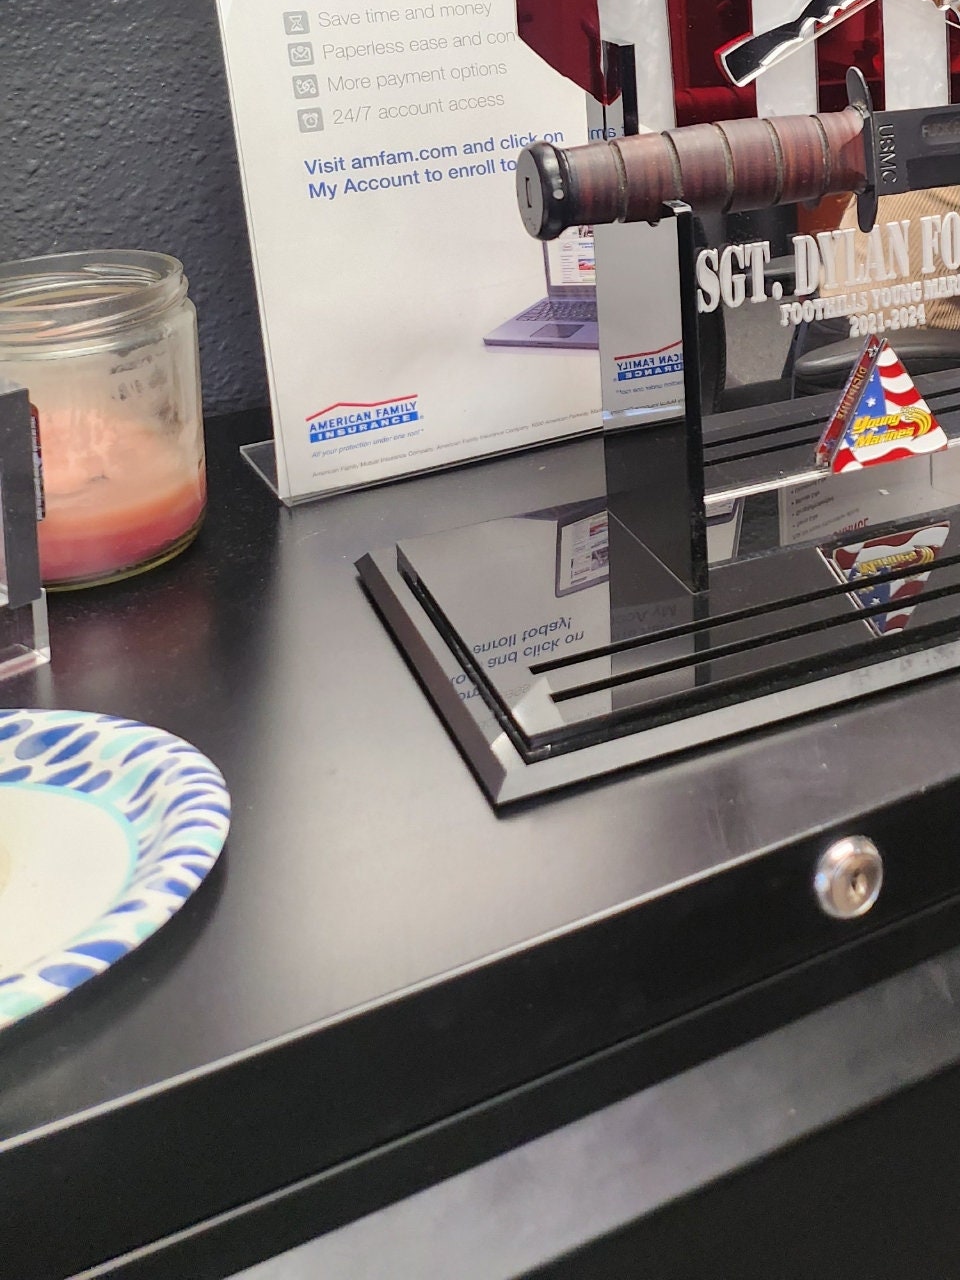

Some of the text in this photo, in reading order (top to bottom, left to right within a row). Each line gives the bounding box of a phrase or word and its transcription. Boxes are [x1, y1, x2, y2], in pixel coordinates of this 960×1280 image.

[318, 2, 492, 28] Save time and money
[322, 40, 405, 61] Paperless
[409, 37, 448, 52] ease
[452, 31, 482, 48] and
[327, 61, 508, 92] More payment options
[332, 93, 505, 125] 24/7 account access
[304, 131, 564, 176] Visit amfam.com and click on
[878, 123, 898, 185] USMC
[308, 157, 518, 201] My Account to enroll to
[696, 240, 783, 314] SGT.
[792, 219, 911, 297] DYLAN
[779, 291, 869, 327] FOOTHILLS
[871, 281, 924, 310] YOUNG
[848, 303, 927, 338] 2021-2024
[309, 401, 417, 433] AMERICAN FAMILY
[317, 413, 412, 441] INSURANCE
[853, 413, 901, 435] Young
[855, 427, 915, 448] Marines
